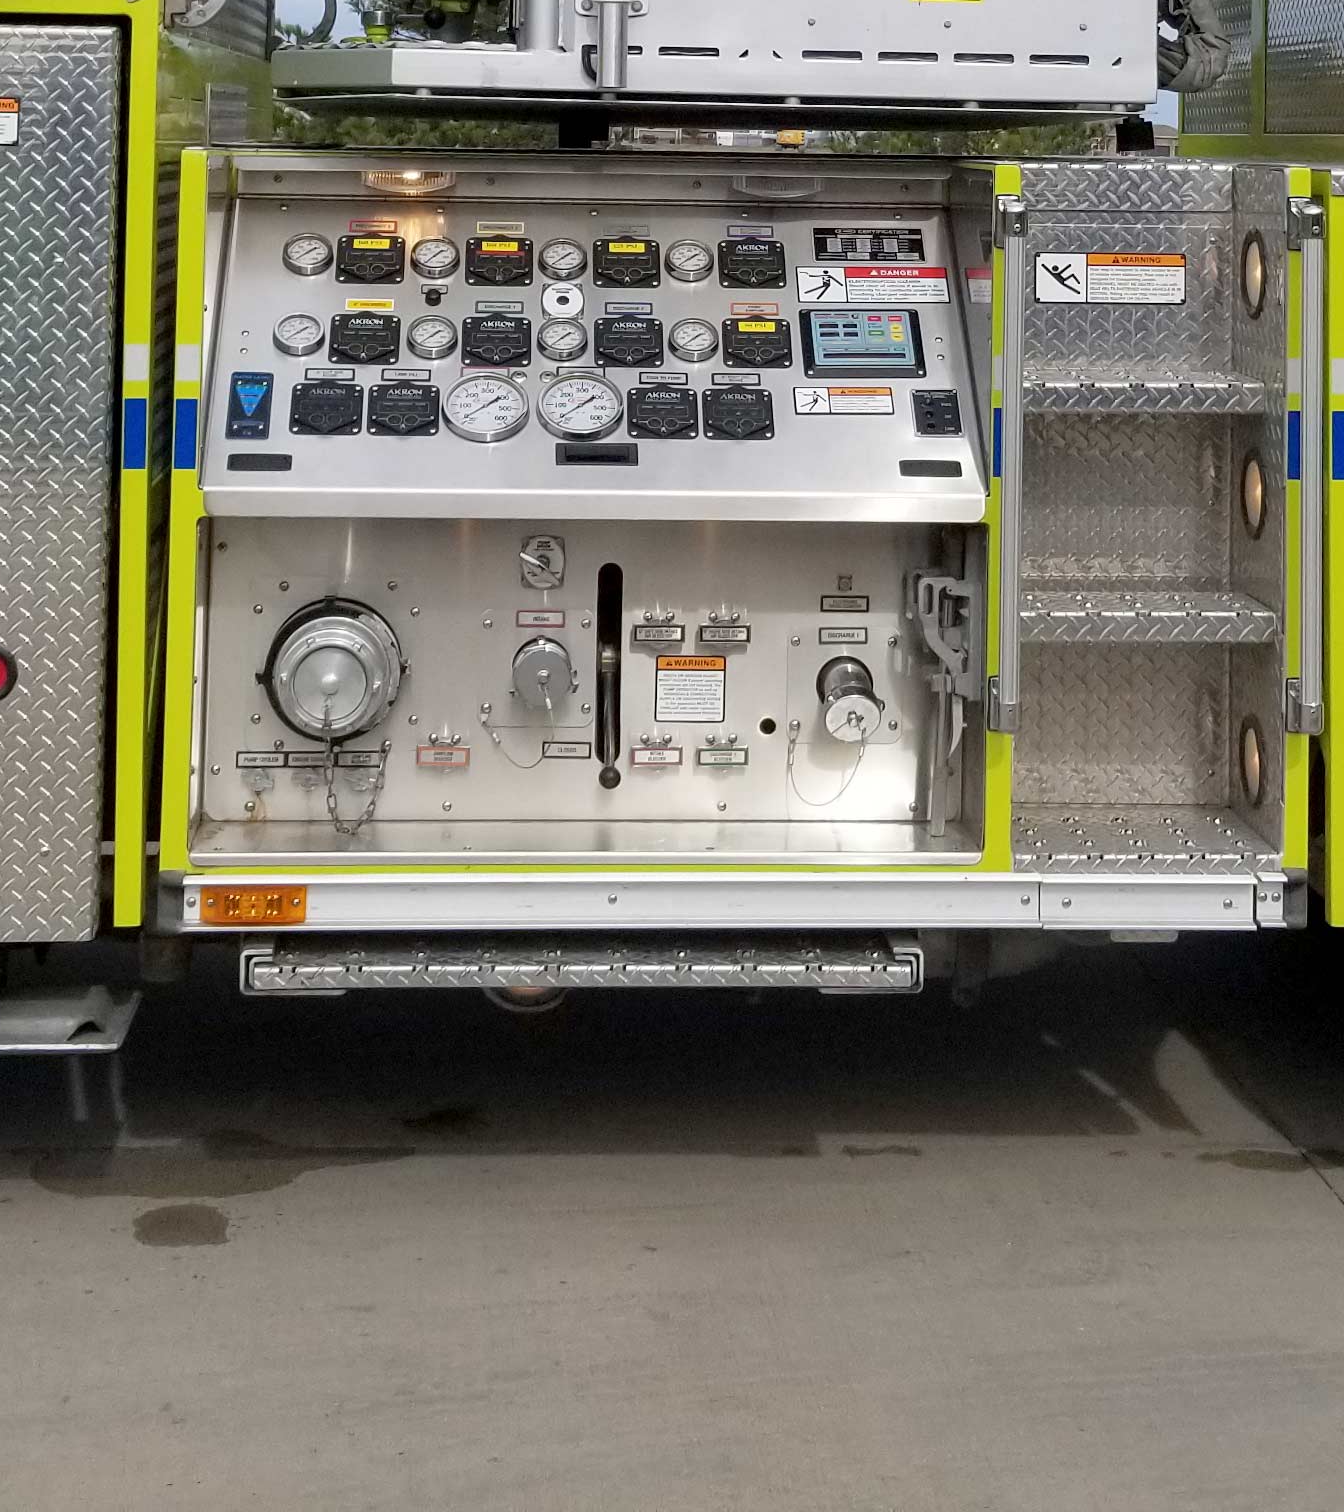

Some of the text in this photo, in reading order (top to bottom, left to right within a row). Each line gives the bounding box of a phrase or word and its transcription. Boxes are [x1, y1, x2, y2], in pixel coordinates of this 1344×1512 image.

[1121, 256, 1161, 264] WARNING
[348, 317, 384, 326] AKRON
[612, 321, 647, 329] AKRON
[387, 388, 423, 396] AKRON
[674, 659, 717, 667] WARNING
